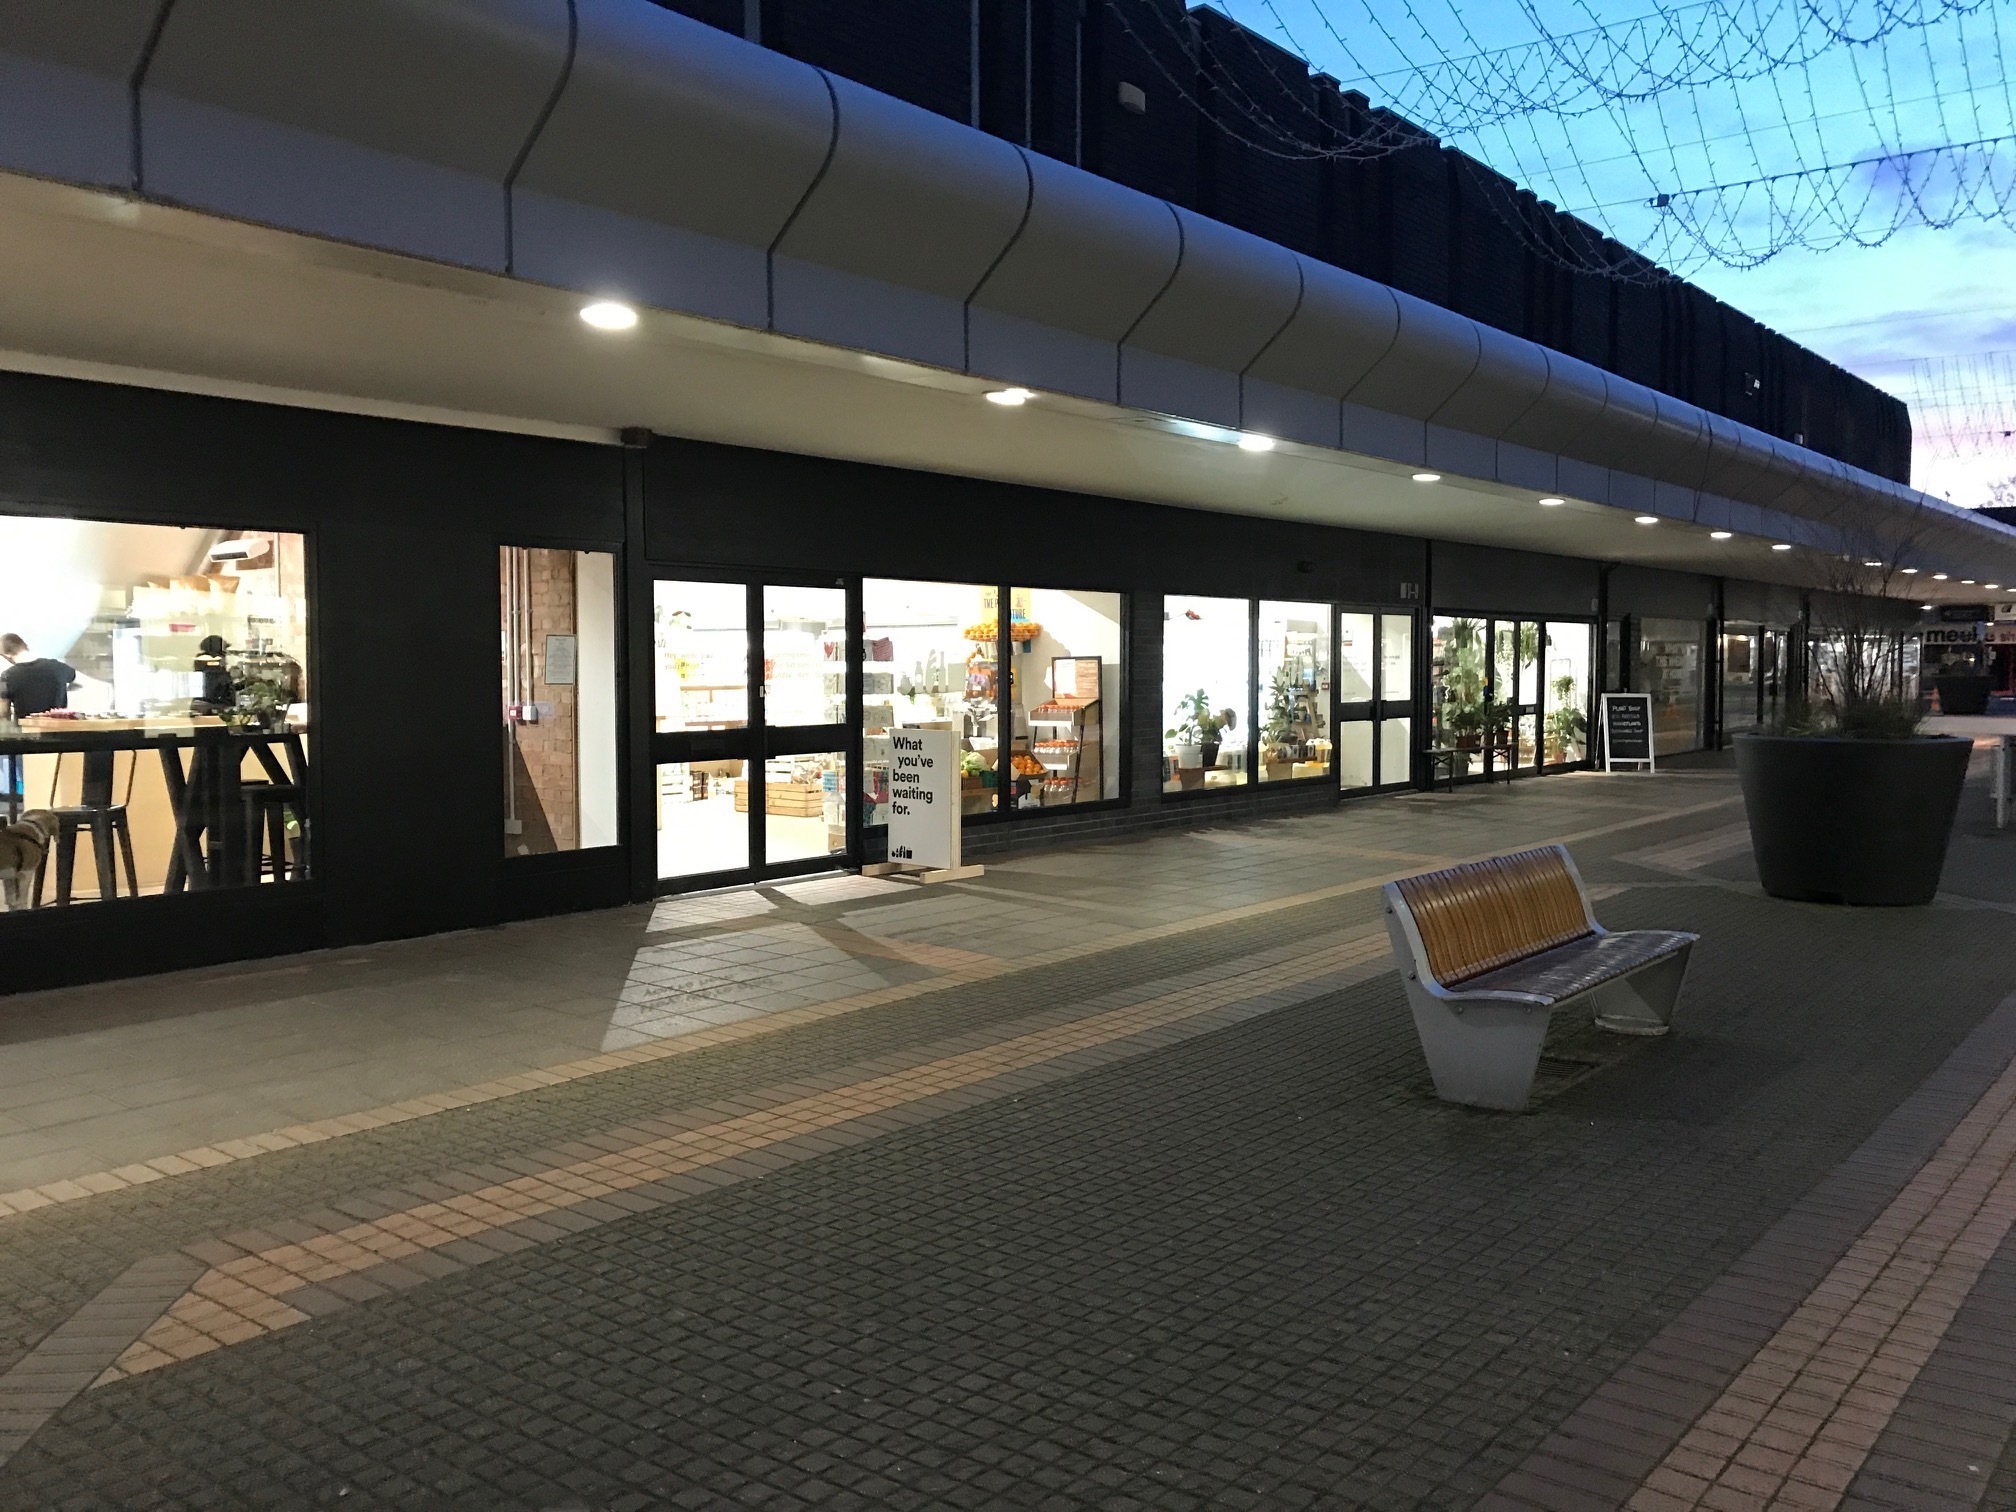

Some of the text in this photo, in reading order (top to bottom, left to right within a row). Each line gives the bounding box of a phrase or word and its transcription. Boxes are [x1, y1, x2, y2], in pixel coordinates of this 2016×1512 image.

[892, 736, 923, 751] What
[897, 754, 934, 770] you've
[892, 769, 920, 783] been
[892, 786, 934, 804] waiting
[891, 801, 911, 816] for.
